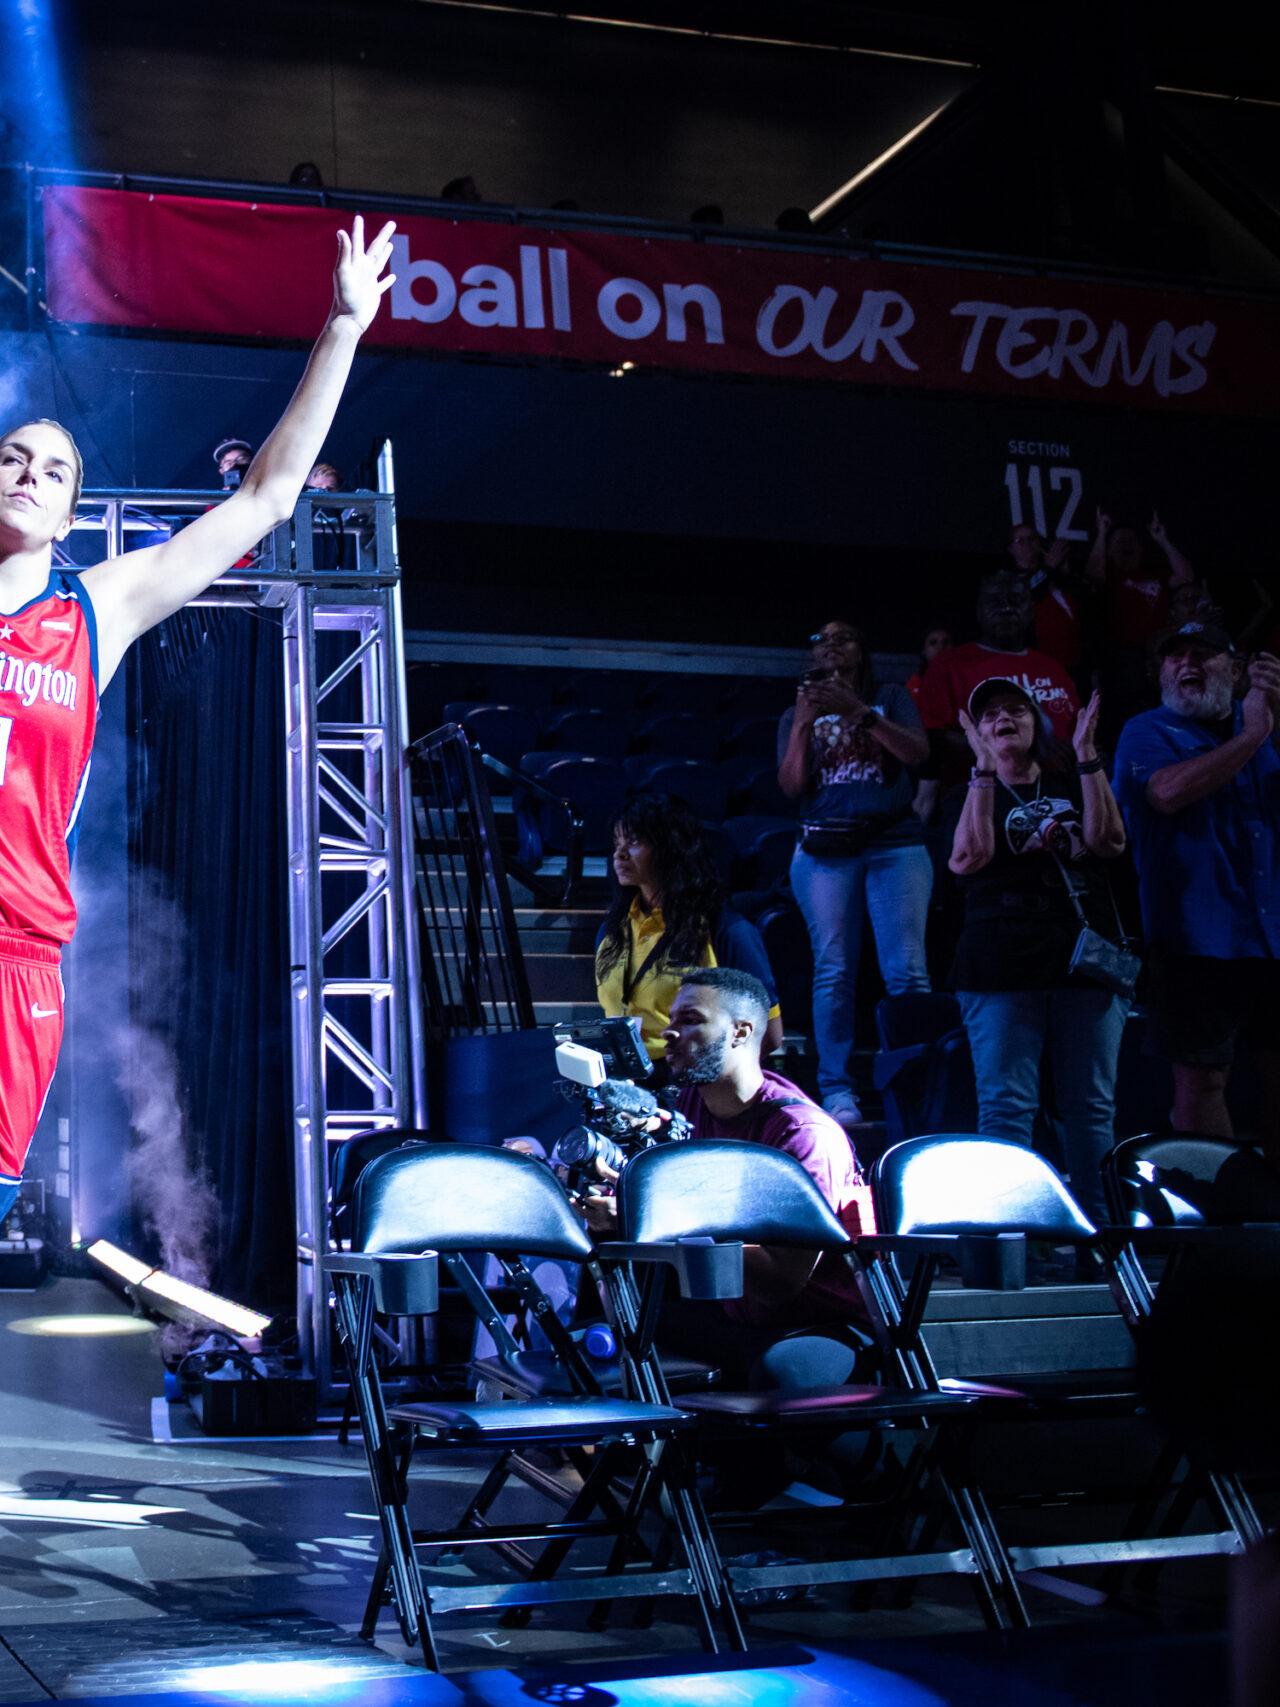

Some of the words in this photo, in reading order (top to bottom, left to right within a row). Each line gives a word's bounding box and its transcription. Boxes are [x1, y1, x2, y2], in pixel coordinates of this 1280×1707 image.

[390, 233, 572, 333] ball
[597, 276, 725, 345] on
[755, 284, 920, 371] OUR
[950, 300, 1218, 398] TERMS
[1008, 439, 1070, 458] SECTION
[1004, 462, 1089, 542] 112
